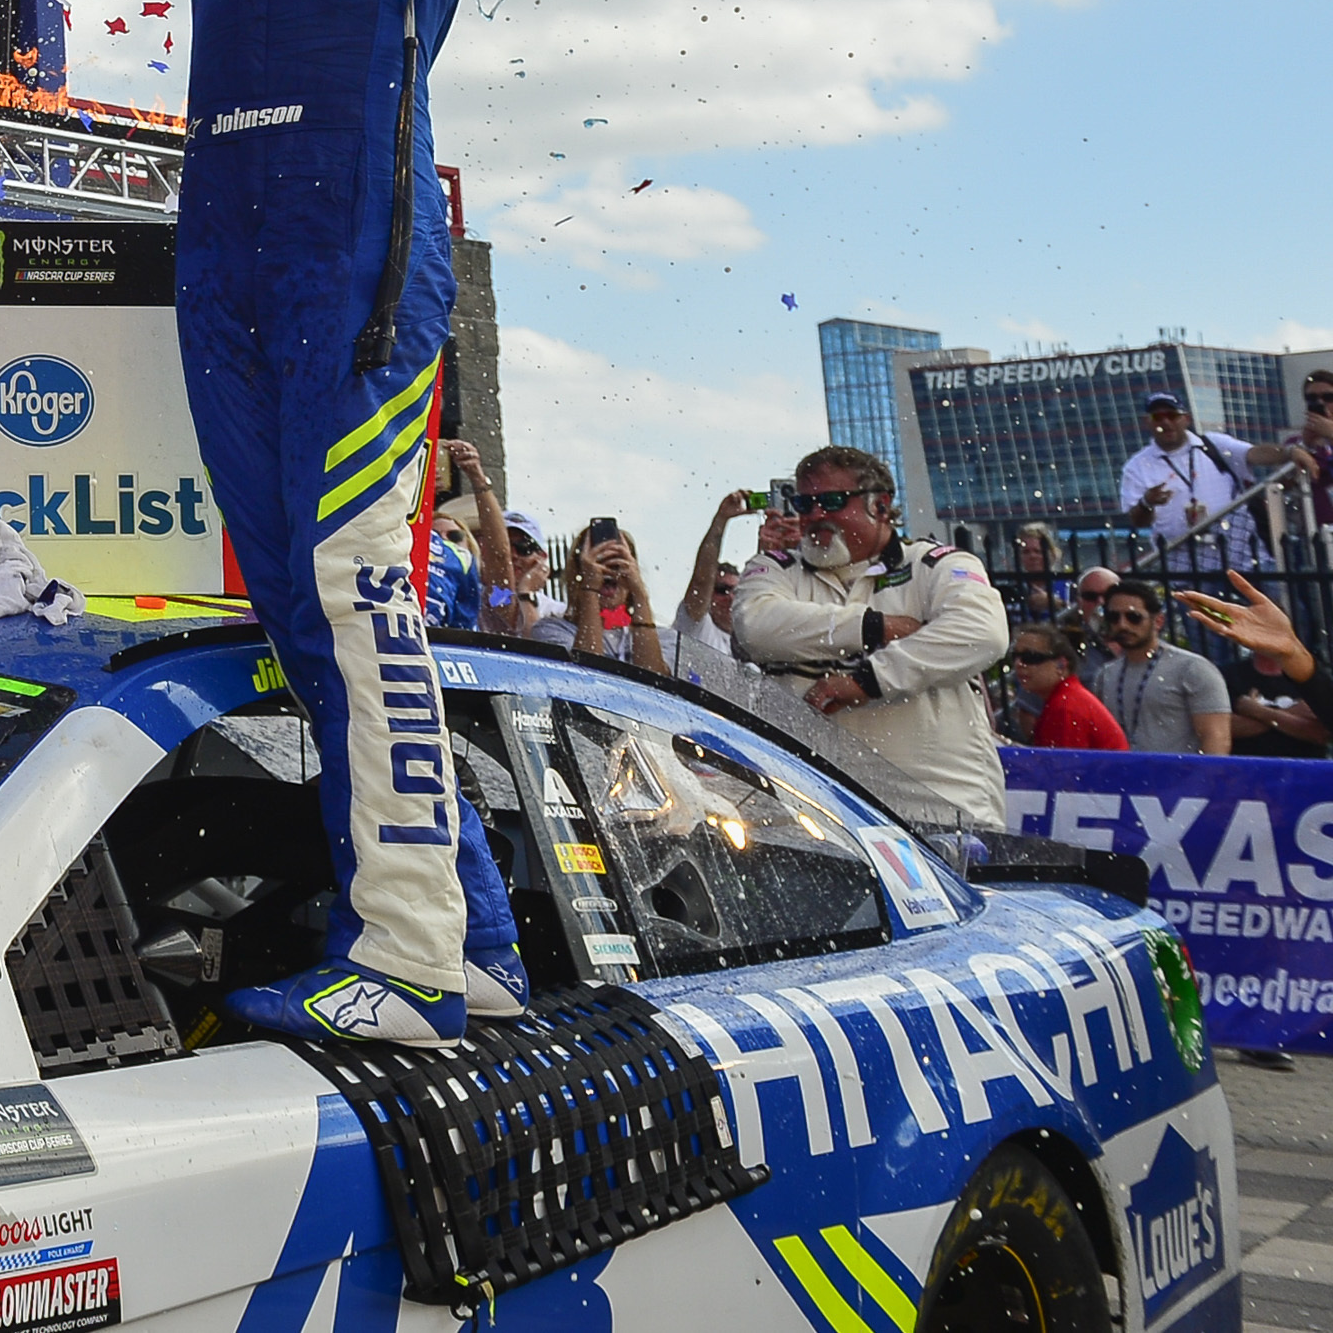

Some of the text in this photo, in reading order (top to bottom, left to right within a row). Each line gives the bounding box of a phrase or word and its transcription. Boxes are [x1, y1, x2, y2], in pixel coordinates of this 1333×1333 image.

[211, 104, 304, 136] Johnson
[12, 236, 116, 256] MONSTER
[29, 258, 101, 266] ENERGY
[26, 270, 116, 282] NASCAR CUP SERIES
[924, 351, 1166, 390] THE SPEEDWAY CLUB
[0, 370, 85, 435] Kroger
[353, 565, 453, 847] LOWE'S
[512, 711, 553, 731] Hendrick
[544, 804, 586, 820] AXALTA
[572, 846, 598, 858] BOSCH
[577, 859, 603, 871] BOSCH
[593, 943, 633, 956] SIEMENS
[1199, 968, 1333, 1015] peedwa
[667, 925, 1152, 1167] HITACHI
[29, 1138, 45, 1151] CUP
[45, 1135, 73, 1149] SERIES
[42, 1208, 93, 1237] LIGHT
[1135, 1180, 1217, 1300] LOWE'S
[47, 1244, 85, 1259] POLE AWARD
[32, 1314, 108, 1333] TECHNOLOGY COMPANY
